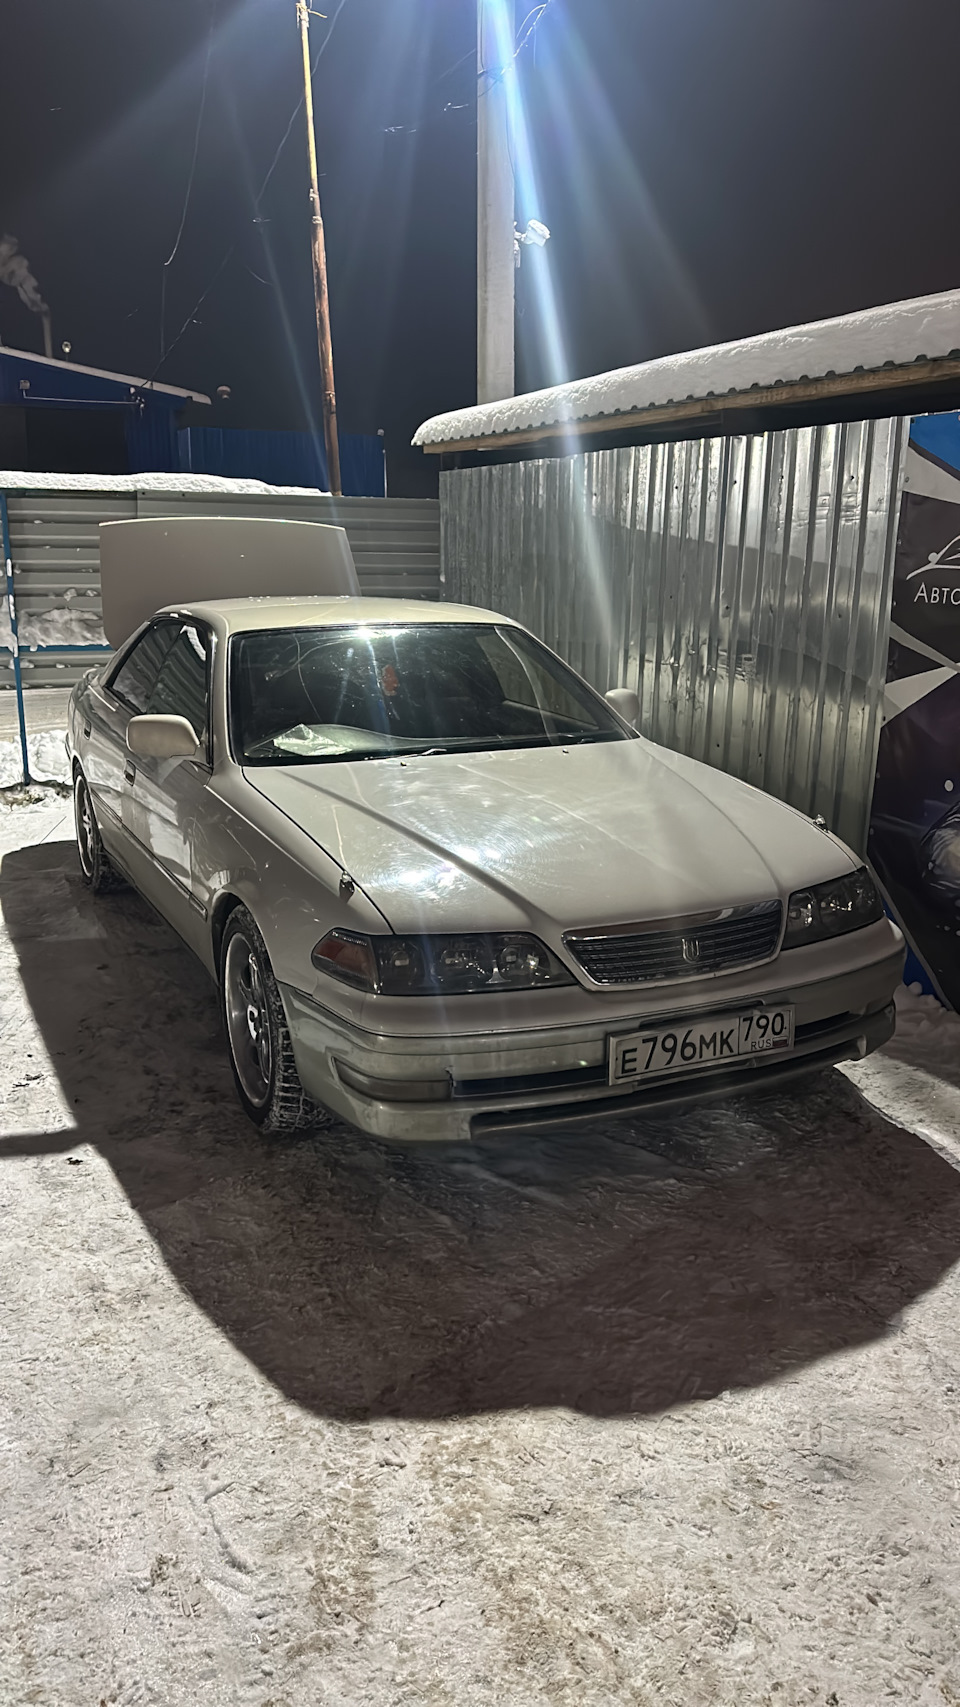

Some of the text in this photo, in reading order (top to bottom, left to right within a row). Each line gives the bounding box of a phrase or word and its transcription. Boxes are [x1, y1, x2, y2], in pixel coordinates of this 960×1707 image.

[621, 1012, 785, 1075] Е796МК 790
[751, 1038, 772, 1050] RUS
